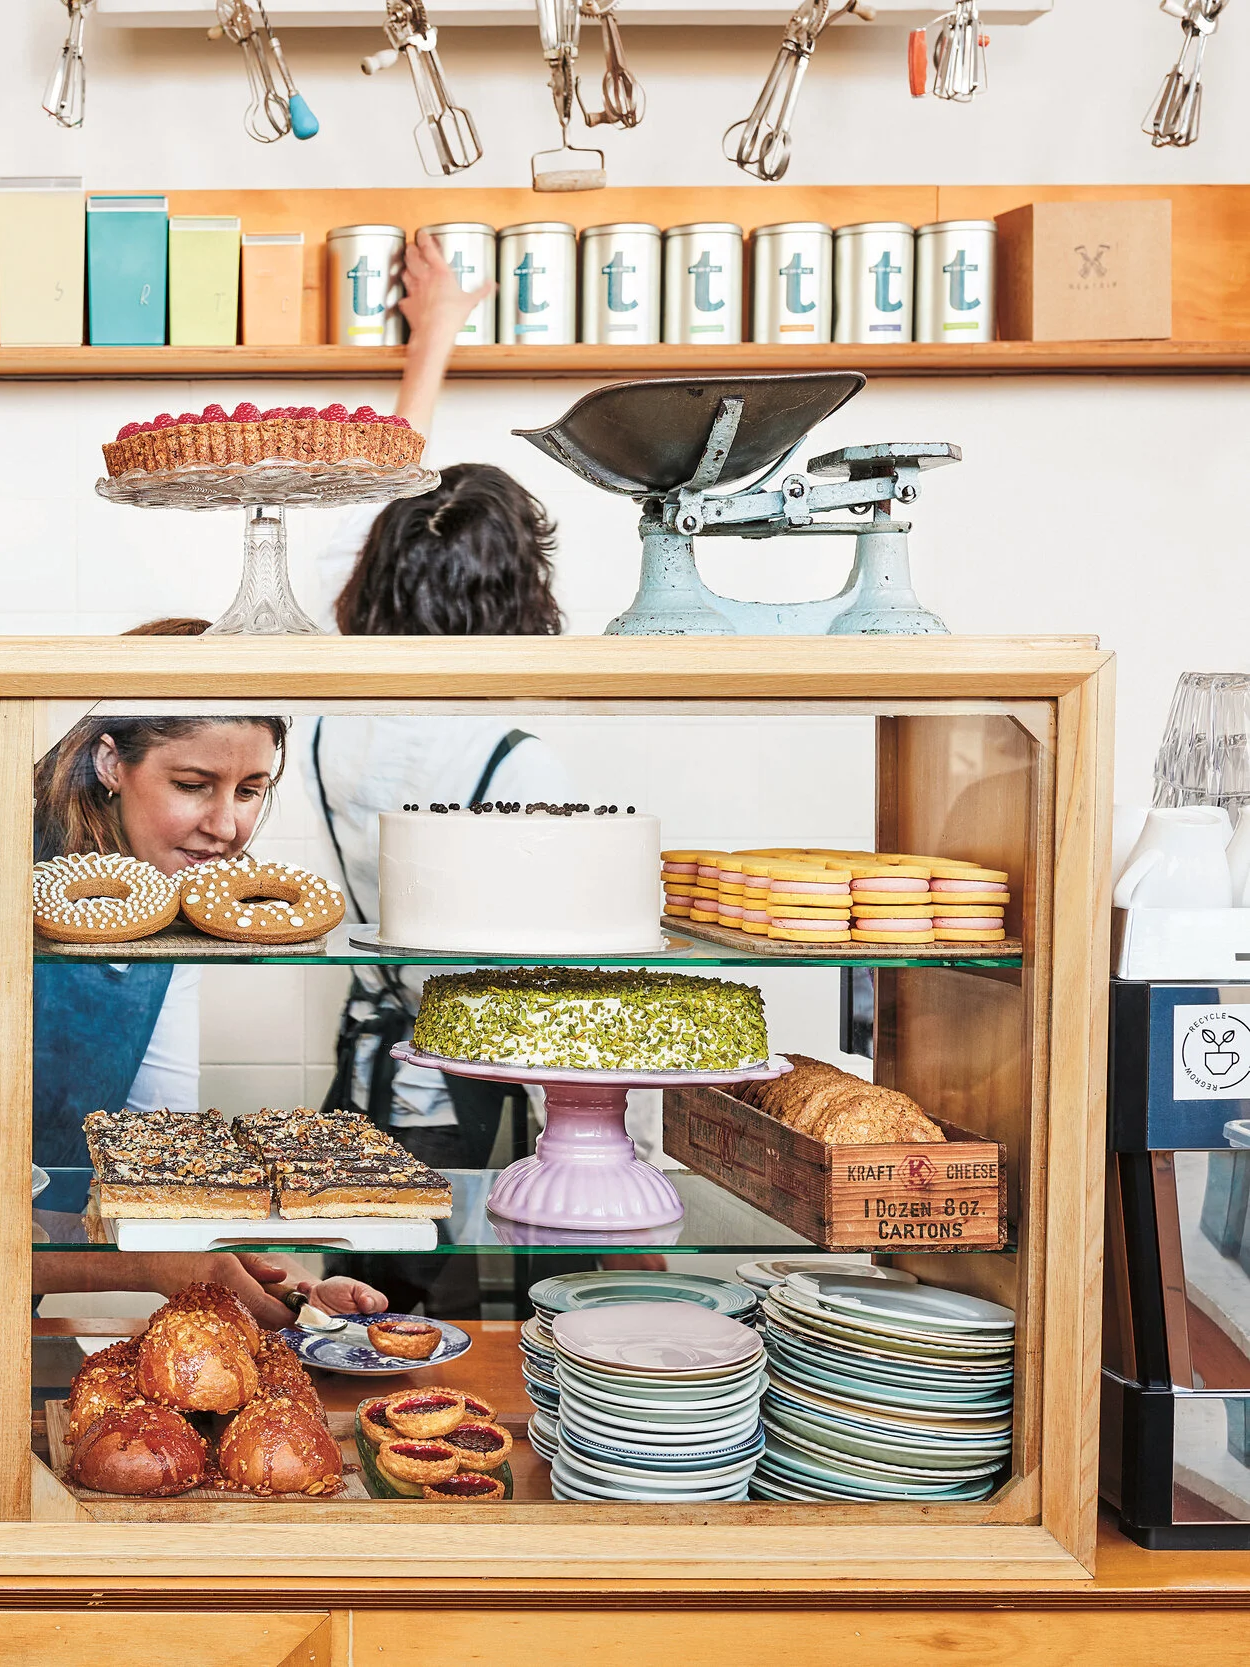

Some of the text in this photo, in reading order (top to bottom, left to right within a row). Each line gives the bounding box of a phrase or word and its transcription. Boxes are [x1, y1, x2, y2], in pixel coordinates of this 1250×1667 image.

[347, 255, 385, 316] t
[514, 252, 550, 314] t
[602, 251, 639, 312] t
[688, 250, 726, 312] t
[779, 252, 817, 314] t
[869, 250, 903, 313] t
[943, 249, 981, 311] t
[1188, 1012, 1227, 1033] RECYCLE
[1184, 1067, 1218, 1092] REGROW
[847, 1165, 896, 1182] KRAFT
[946, 1163, 998, 1180] CHEESE
[876, 1198, 931, 1218] DOZEN
[944, 1197, 956, 1217] 8
[878, 1219, 963, 1240] CARTONS
